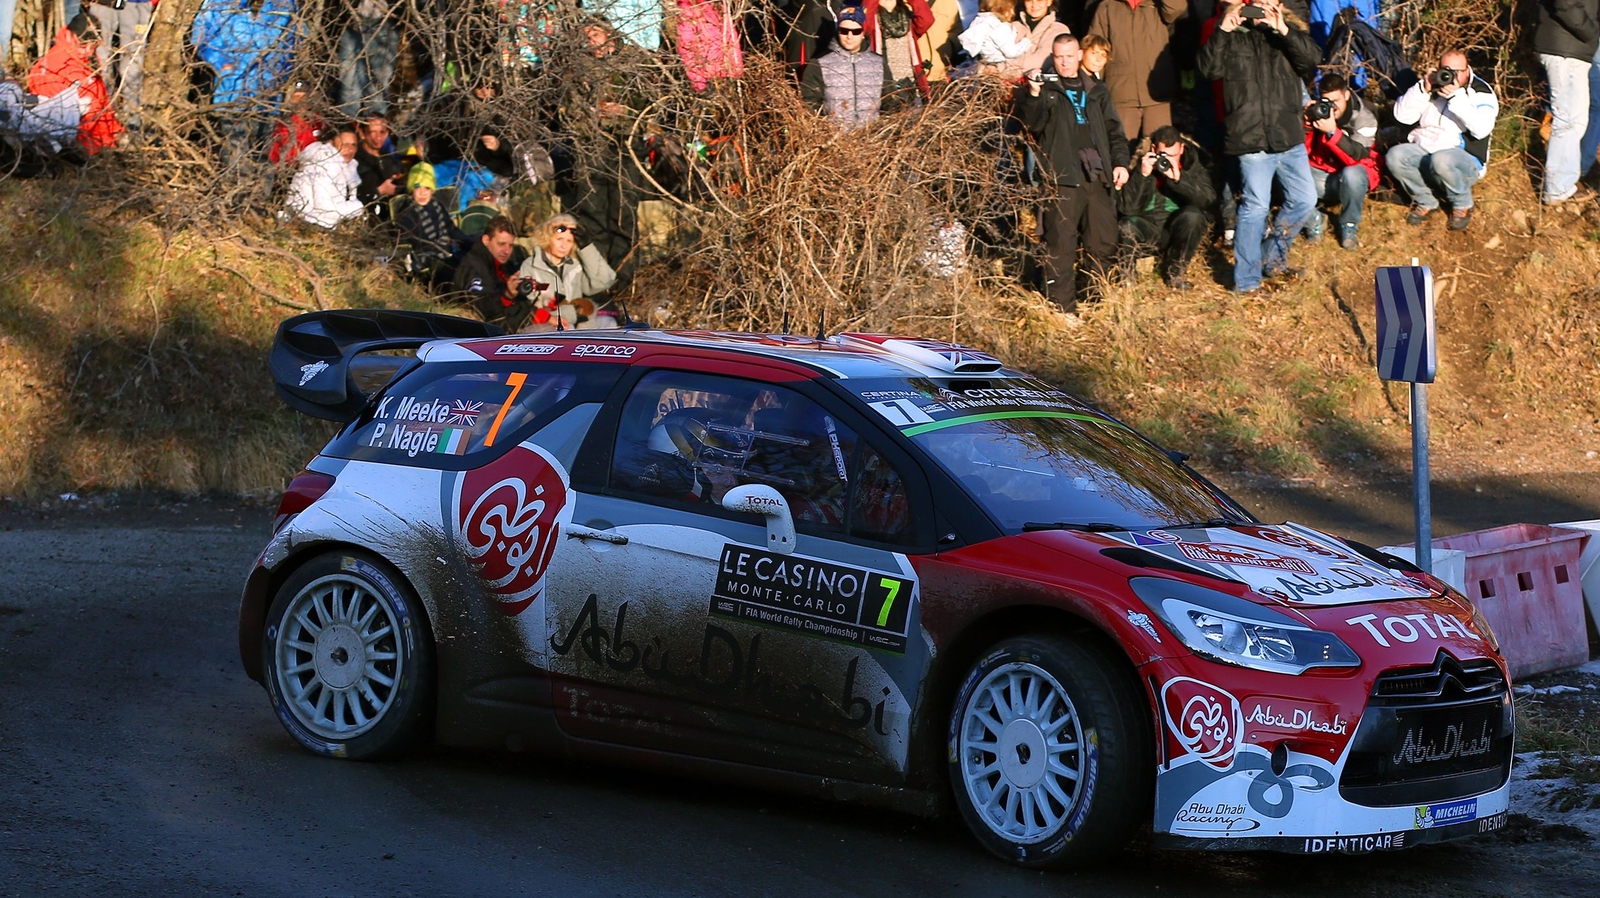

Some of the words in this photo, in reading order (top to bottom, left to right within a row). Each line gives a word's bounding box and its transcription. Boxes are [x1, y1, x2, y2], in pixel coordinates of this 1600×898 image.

[571, 343, 637, 358] sparco
[373, 396, 394, 419] K.
[394, 396, 450, 423] Meeke
[483, 372, 528, 447] 7
[881, 401, 915, 423] 7
[369, 423, 386, 448] P.
[388, 424, 438, 457] Nagle
[745, 495, 783, 507] TOTAL
[723, 550, 750, 576] LE
[755, 557, 858, 598] CASINO
[727, 580, 782, 602] MONTE
[793, 594, 846, 615] CARLO
[877, 577, 901, 627] 7
[745, 607, 758, 618] FIA
[760, 609, 782, 623] World
[784, 615, 803, 629] Rally
[805, 619, 858, 640] Championship
[1345, 613, 1482, 648] TOTAL
[1289, 708, 1347, 736] Dhabi
[1074, 757, 1097, 831] MICHELIN
[1176, 809, 1241, 830] Racing
[1188, 803, 1214, 814] Abu
[1215, 802, 1246, 815] Dhabi
[1435, 802, 1477, 819] MICHELIN
[1304, 835, 1392, 853] IDENTICAR
